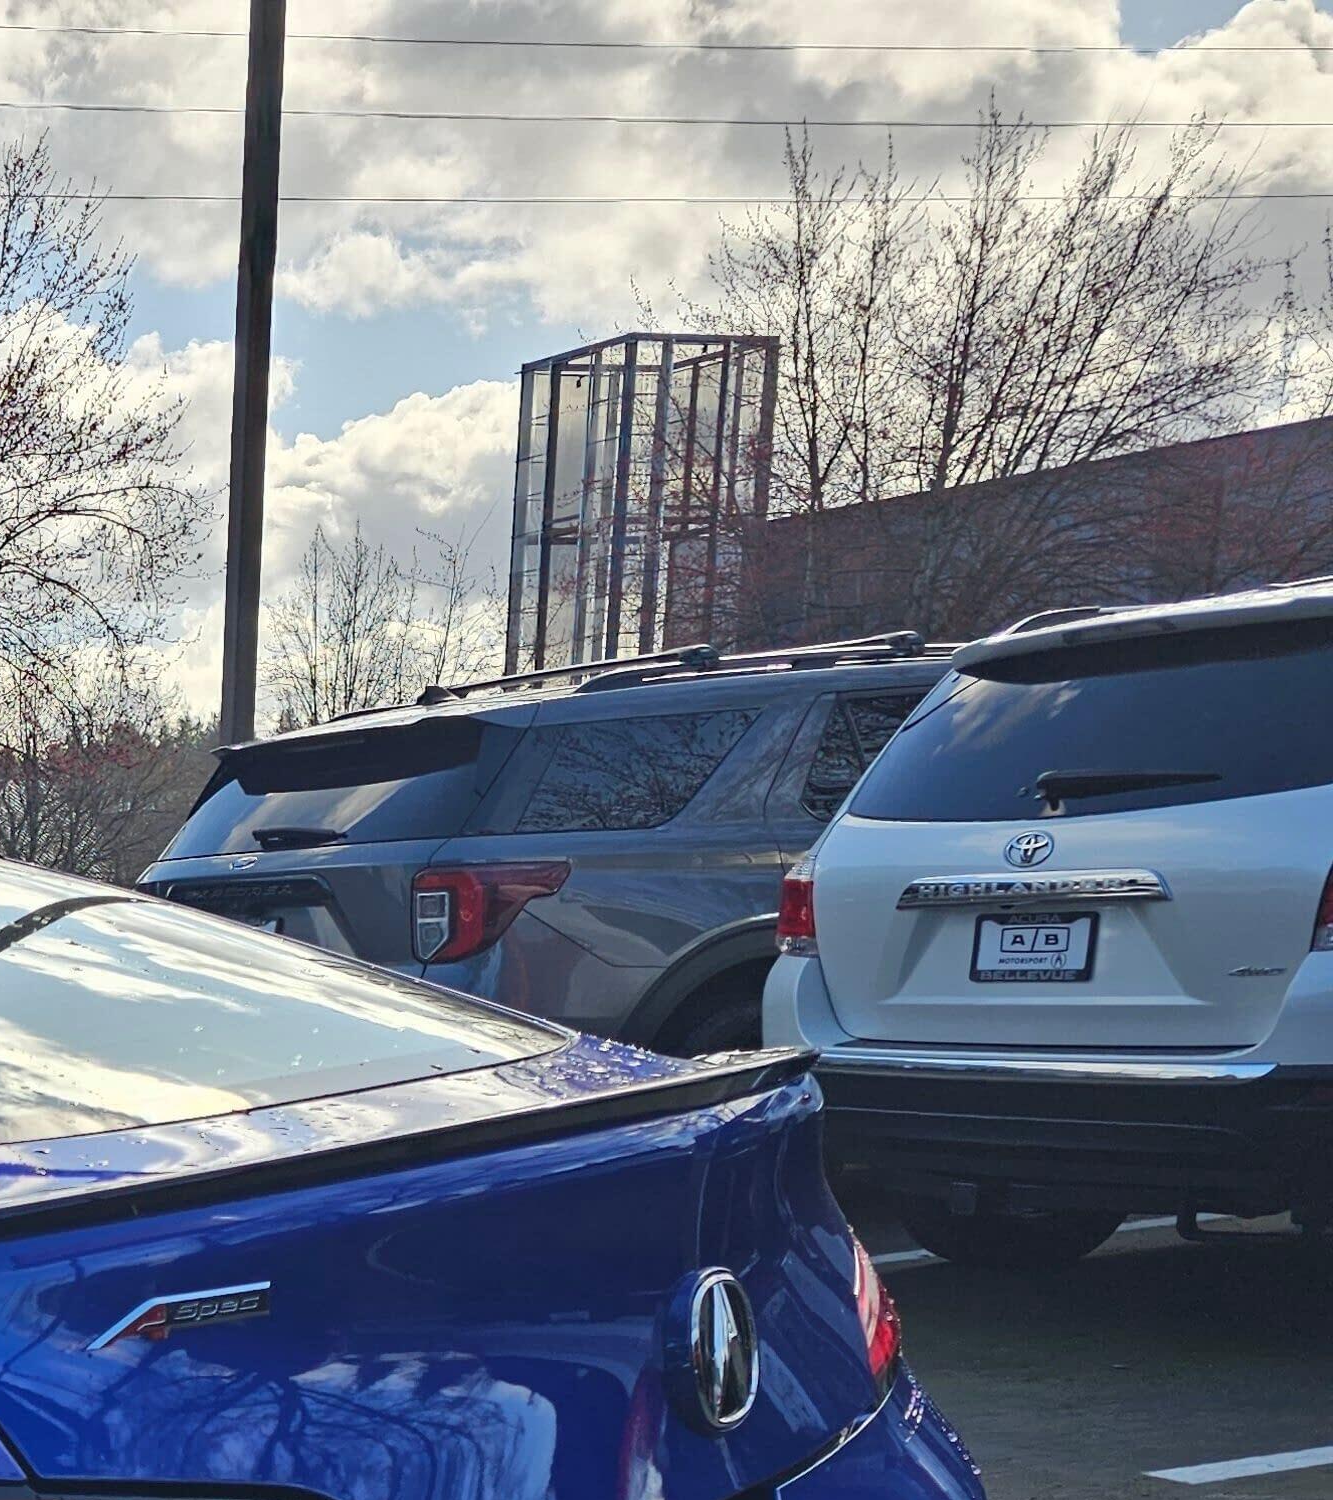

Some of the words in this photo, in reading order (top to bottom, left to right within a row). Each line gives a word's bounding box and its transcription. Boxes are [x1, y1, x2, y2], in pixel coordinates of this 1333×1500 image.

[917, 877, 1123, 899] HIGHLANDER
[1008, 913, 1062, 924] ACURA
[1010, 933, 1027, 946] A
[1043, 933, 1060, 946] B
[998, 956, 1049, 965] MOTORSPORT
[979, 969, 1078, 981] BELLEVUE
